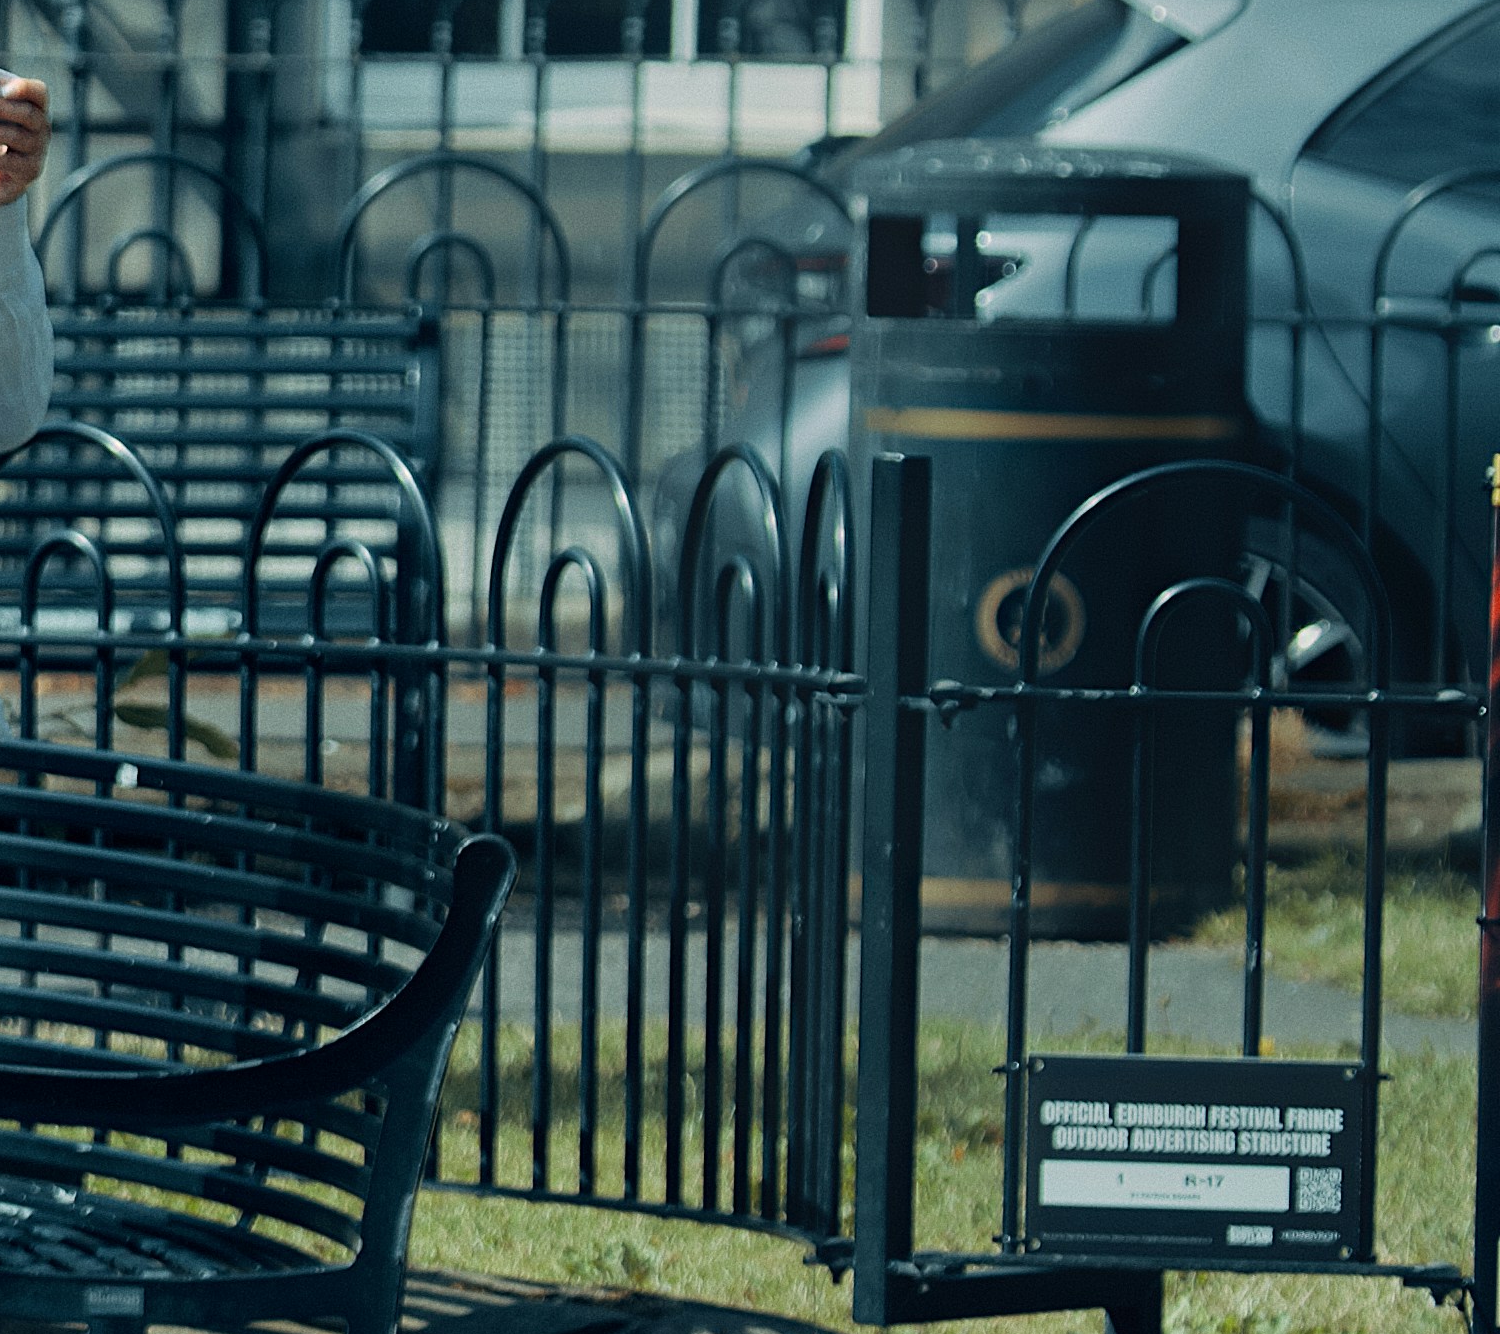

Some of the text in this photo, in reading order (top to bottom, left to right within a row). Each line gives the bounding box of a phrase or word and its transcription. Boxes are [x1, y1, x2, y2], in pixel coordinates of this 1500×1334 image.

[1041, 1100, 1344, 1133] OFFICIAL EDINBURGH FESTIVAL FRINGE
[1052, 1125, 1332, 1157] OUTDOOR ADVERTISING STRUCTURE
[1184, 1173, 1226, 1188] R-17
